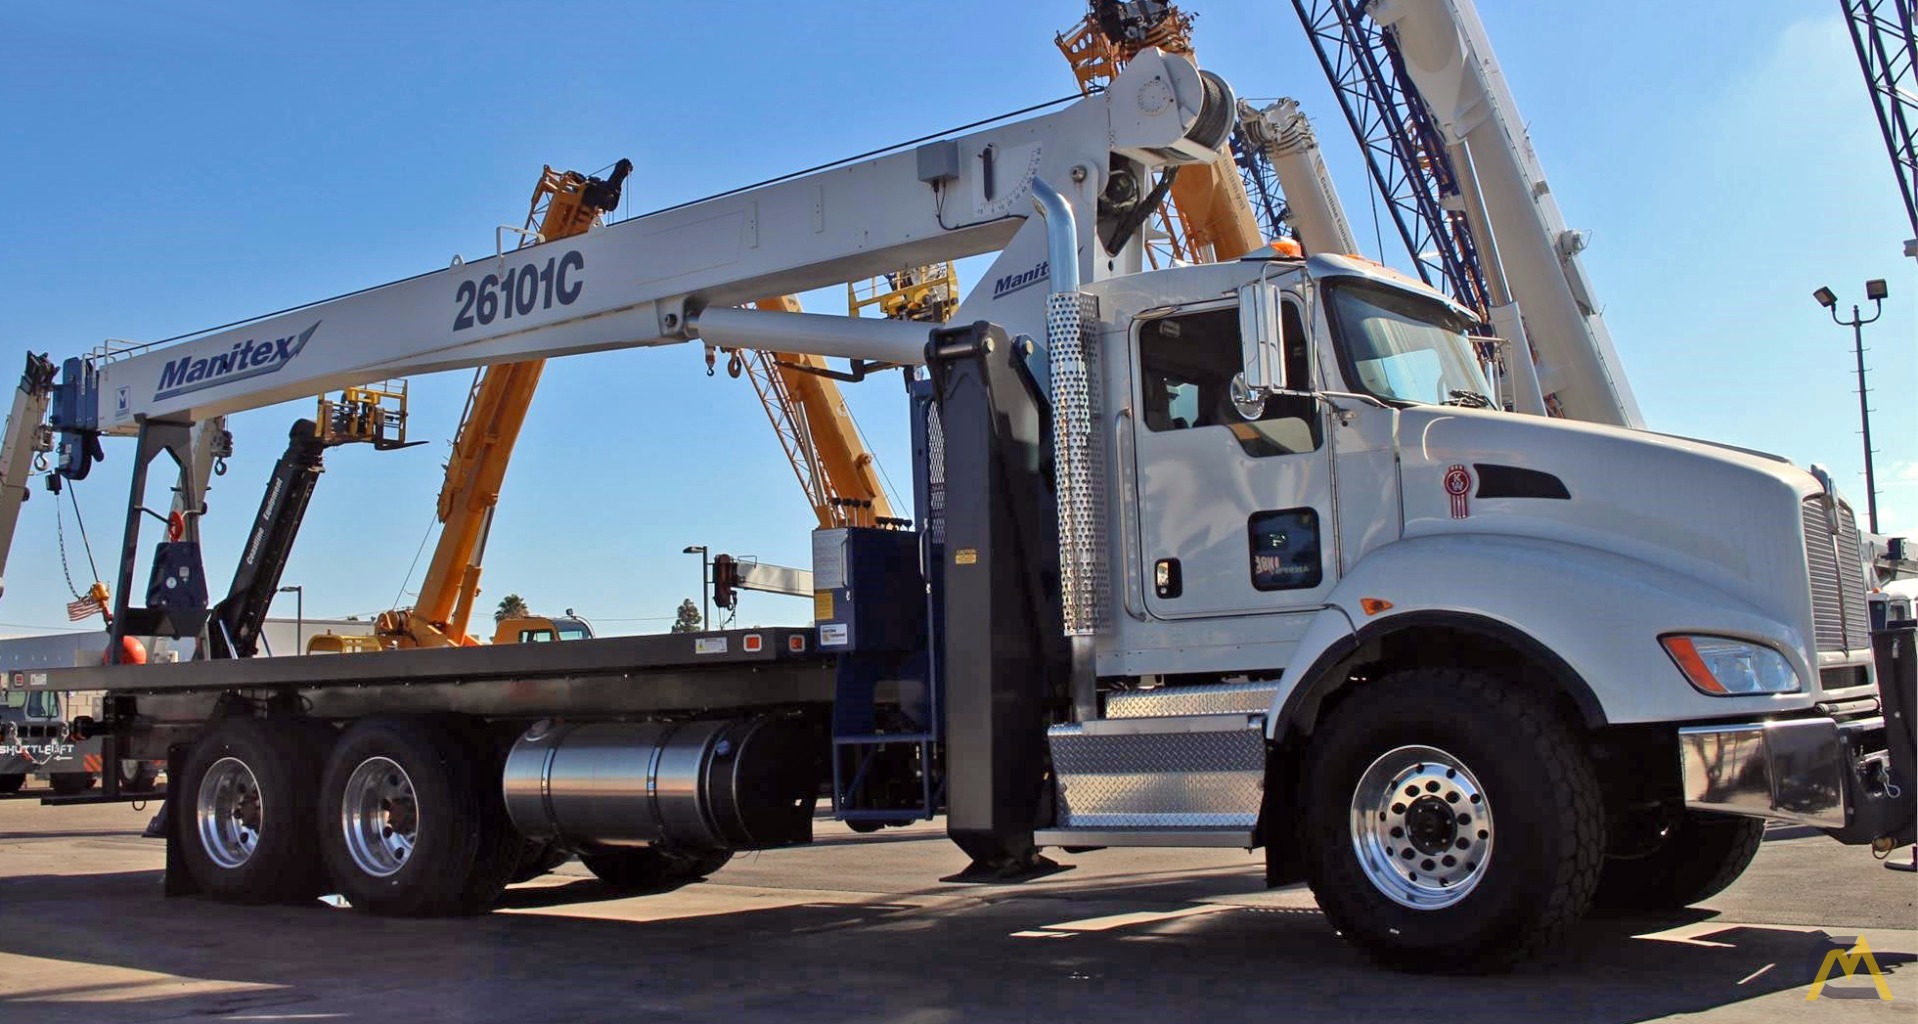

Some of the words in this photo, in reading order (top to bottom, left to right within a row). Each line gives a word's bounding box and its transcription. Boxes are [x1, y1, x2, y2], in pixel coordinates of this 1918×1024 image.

[1336, 218, 1352, 253] Equipm
[453, 250, 584, 332] 26101C
[993, 261, 1050, 295] Manit
[157, 335, 296, 391] Manitex
[246, 526, 265, 565] Coastline
[262, 477, 283, 521] Equipment
